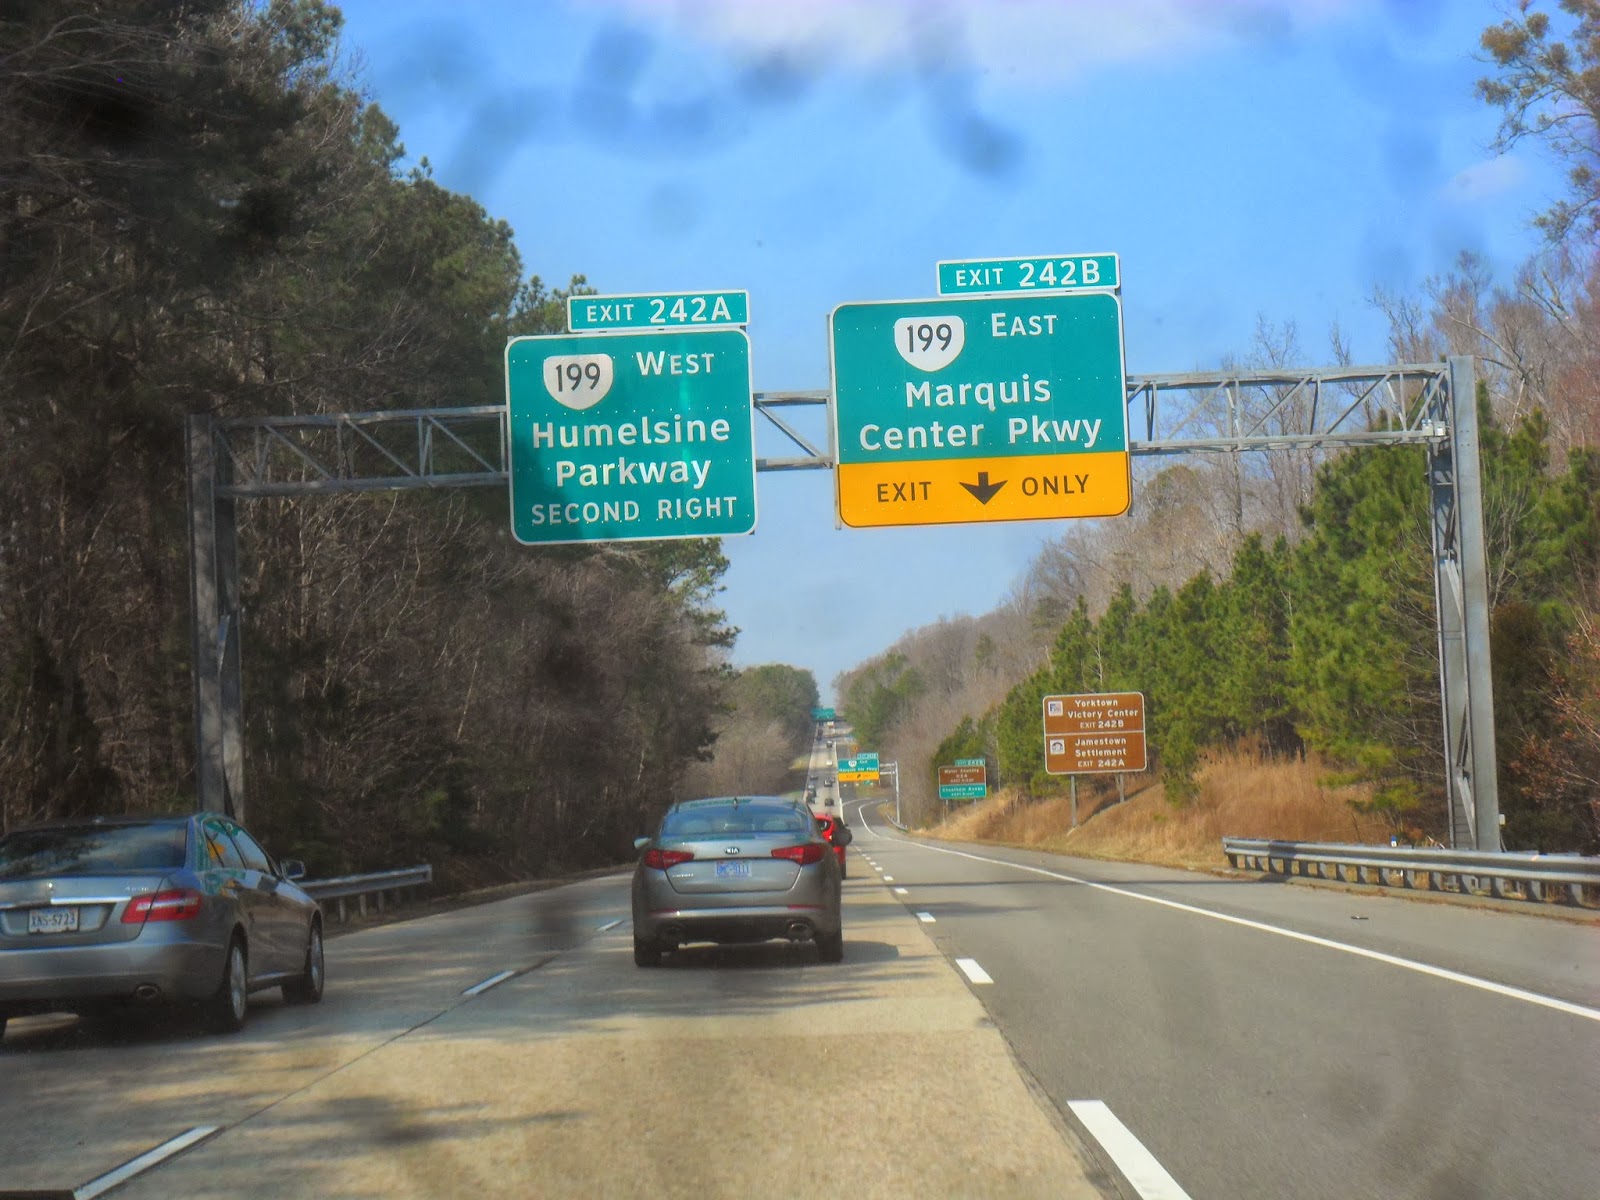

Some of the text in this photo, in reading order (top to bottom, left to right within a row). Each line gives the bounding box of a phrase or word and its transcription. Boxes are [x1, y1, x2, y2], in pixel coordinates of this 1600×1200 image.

[955, 259, 1101, 288] EXIT 242B
[586, 296, 732, 323] EXIT 242A
[906, 323, 952, 353] 199
[991, 312, 1057, 338] EAST
[555, 362, 601, 392] 199
[636, 350, 715, 376] WEST
[905, 373, 1051, 412] Marquis
[532, 414, 731, 449] Humelsine
[859, 414, 1102, 451] Center Pkwy
[555, 456, 712, 490] Parkway
[876, 473, 1090, 503] EXIT ONLY
[531, 495, 738, 526] SECOND RIGHT
[1067, 709, 1139, 719] Victory Center
[1074, 699, 1118, 708] Yorktown
[1080, 719, 1124, 729] EXIT 242B
[1074, 737, 1127, 747] Jamestown
[1075, 748, 1127, 757] Settlement
[1077, 758, 1125, 768] EXIT 242A
